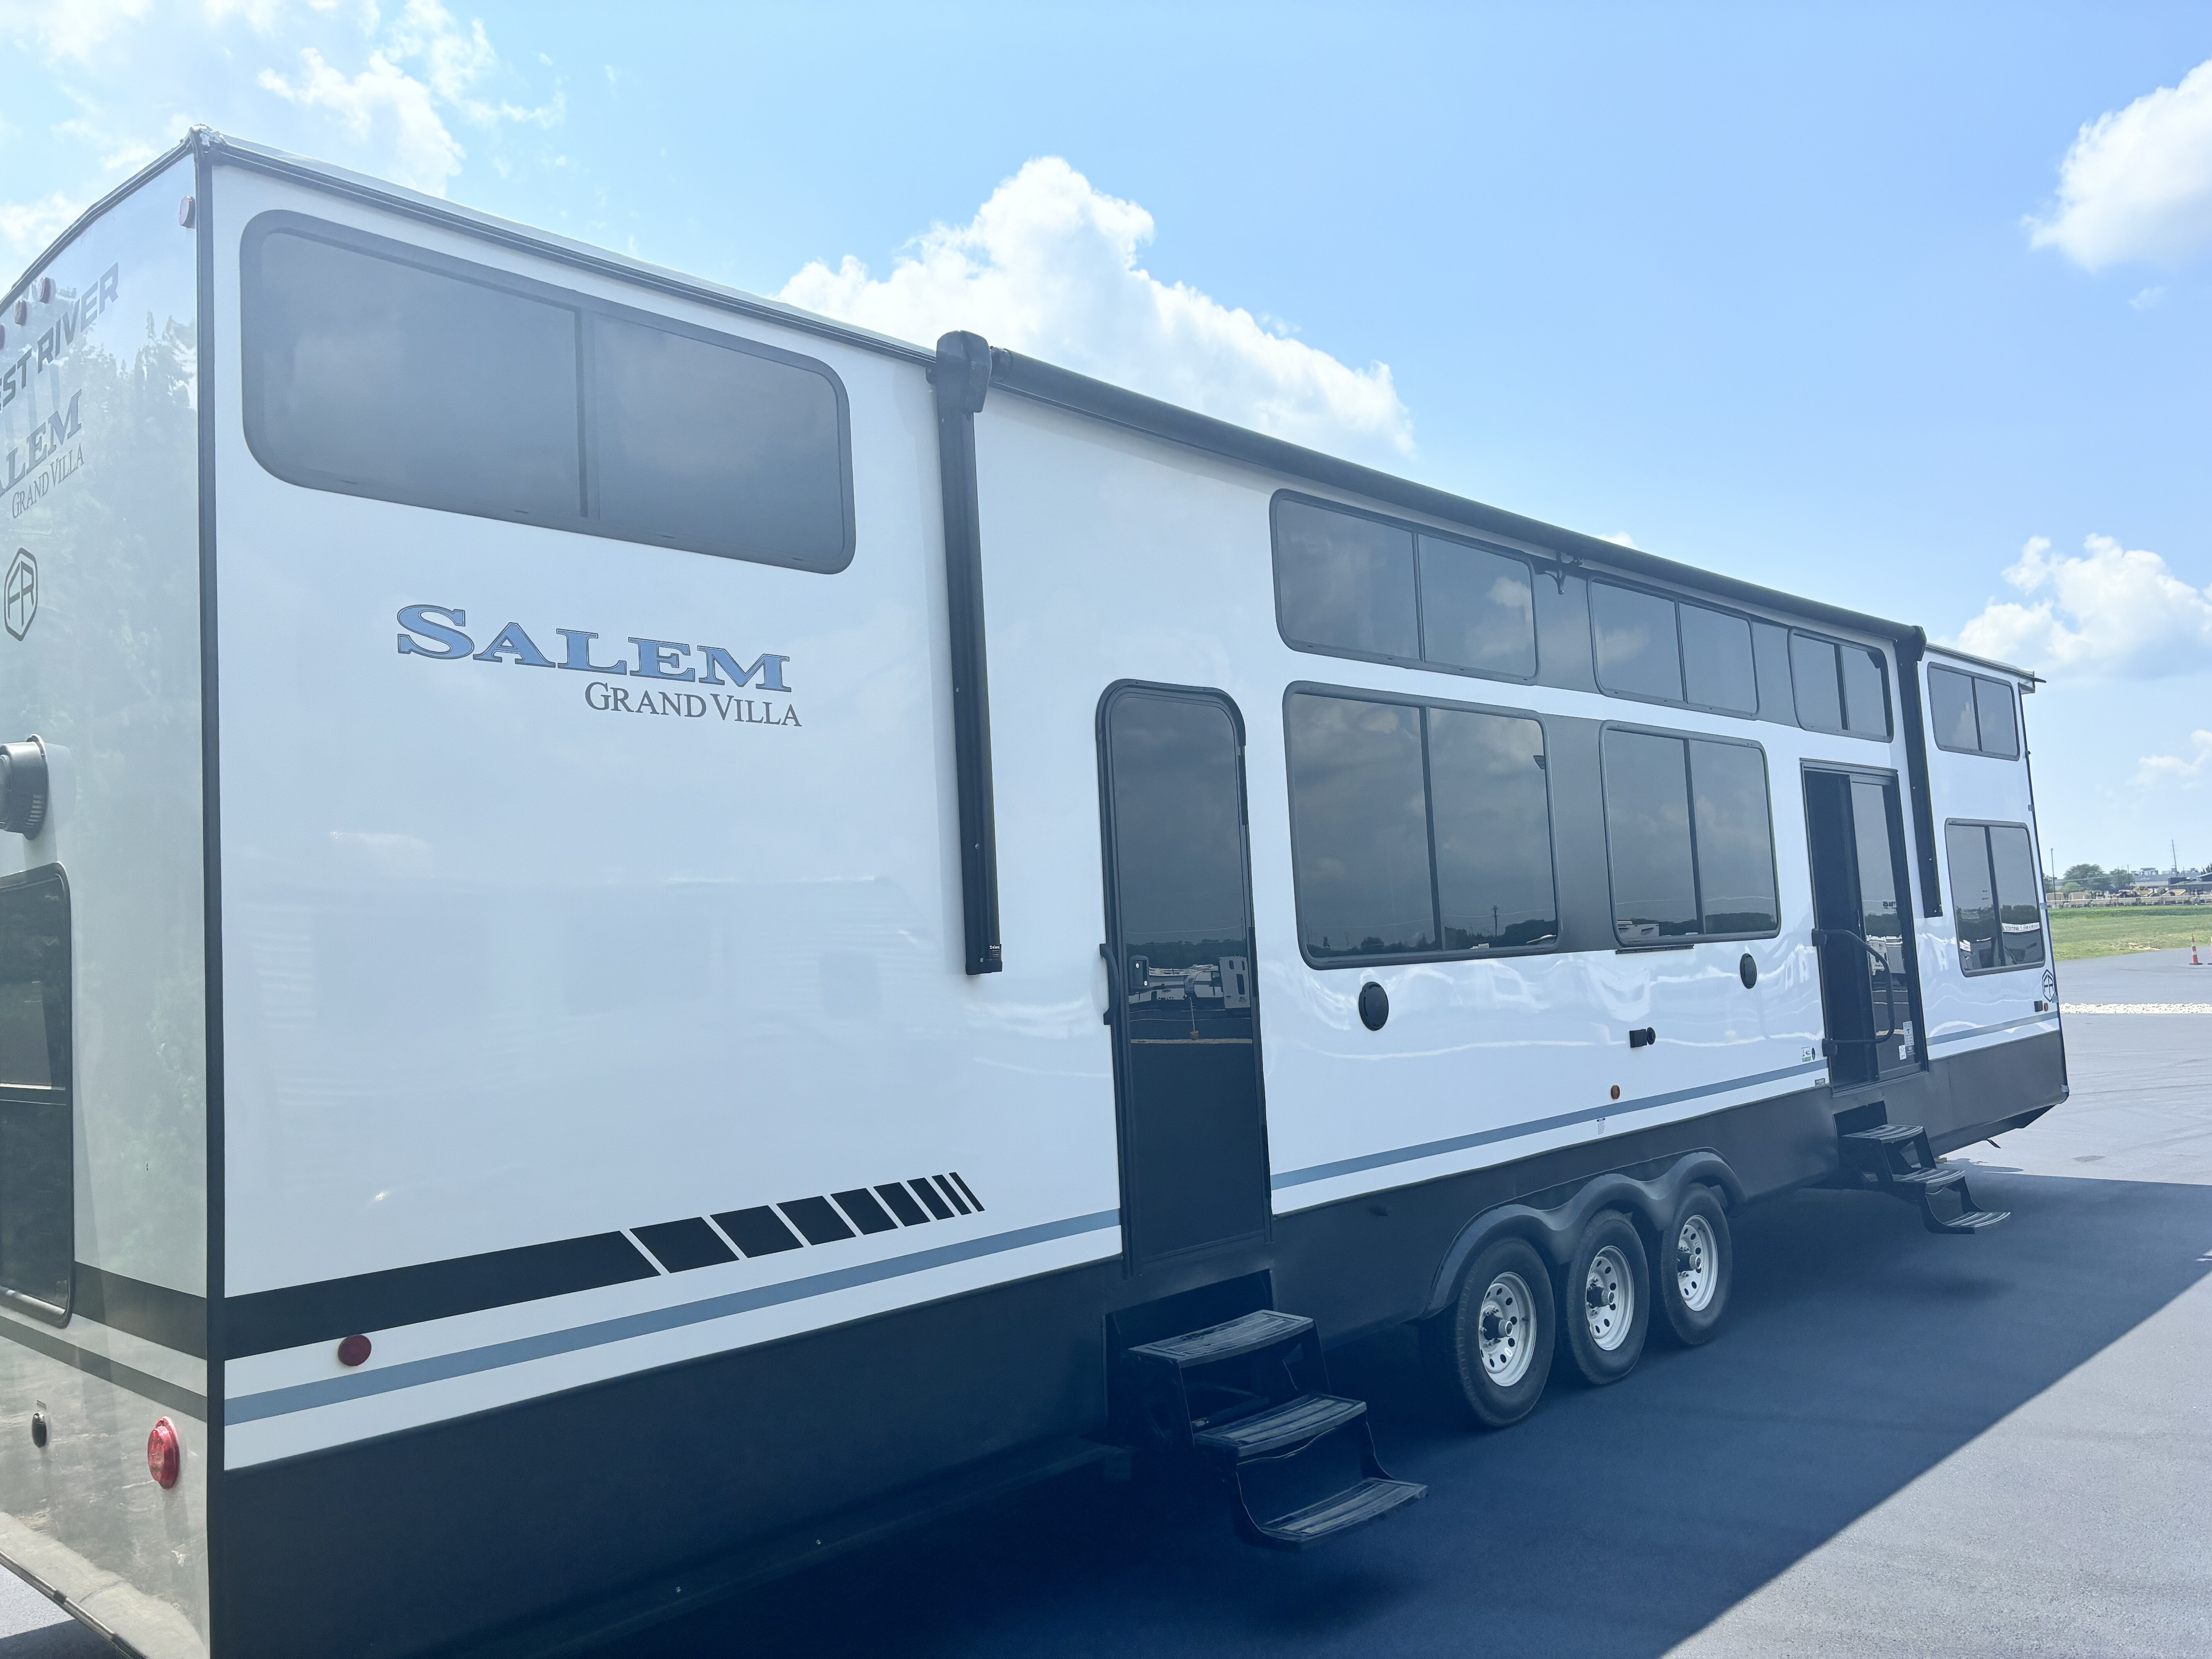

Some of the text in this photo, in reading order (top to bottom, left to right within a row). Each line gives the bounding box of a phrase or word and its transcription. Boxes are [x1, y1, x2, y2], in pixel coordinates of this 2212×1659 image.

[0, 262, 118, 410] ST RIVER
[0, 389, 82, 497] LEM
[12, 443, 84, 518] GRAND VILLA
[397, 604, 792, 692] SALEM
[585, 682, 803, 727] GRAND VILLA
